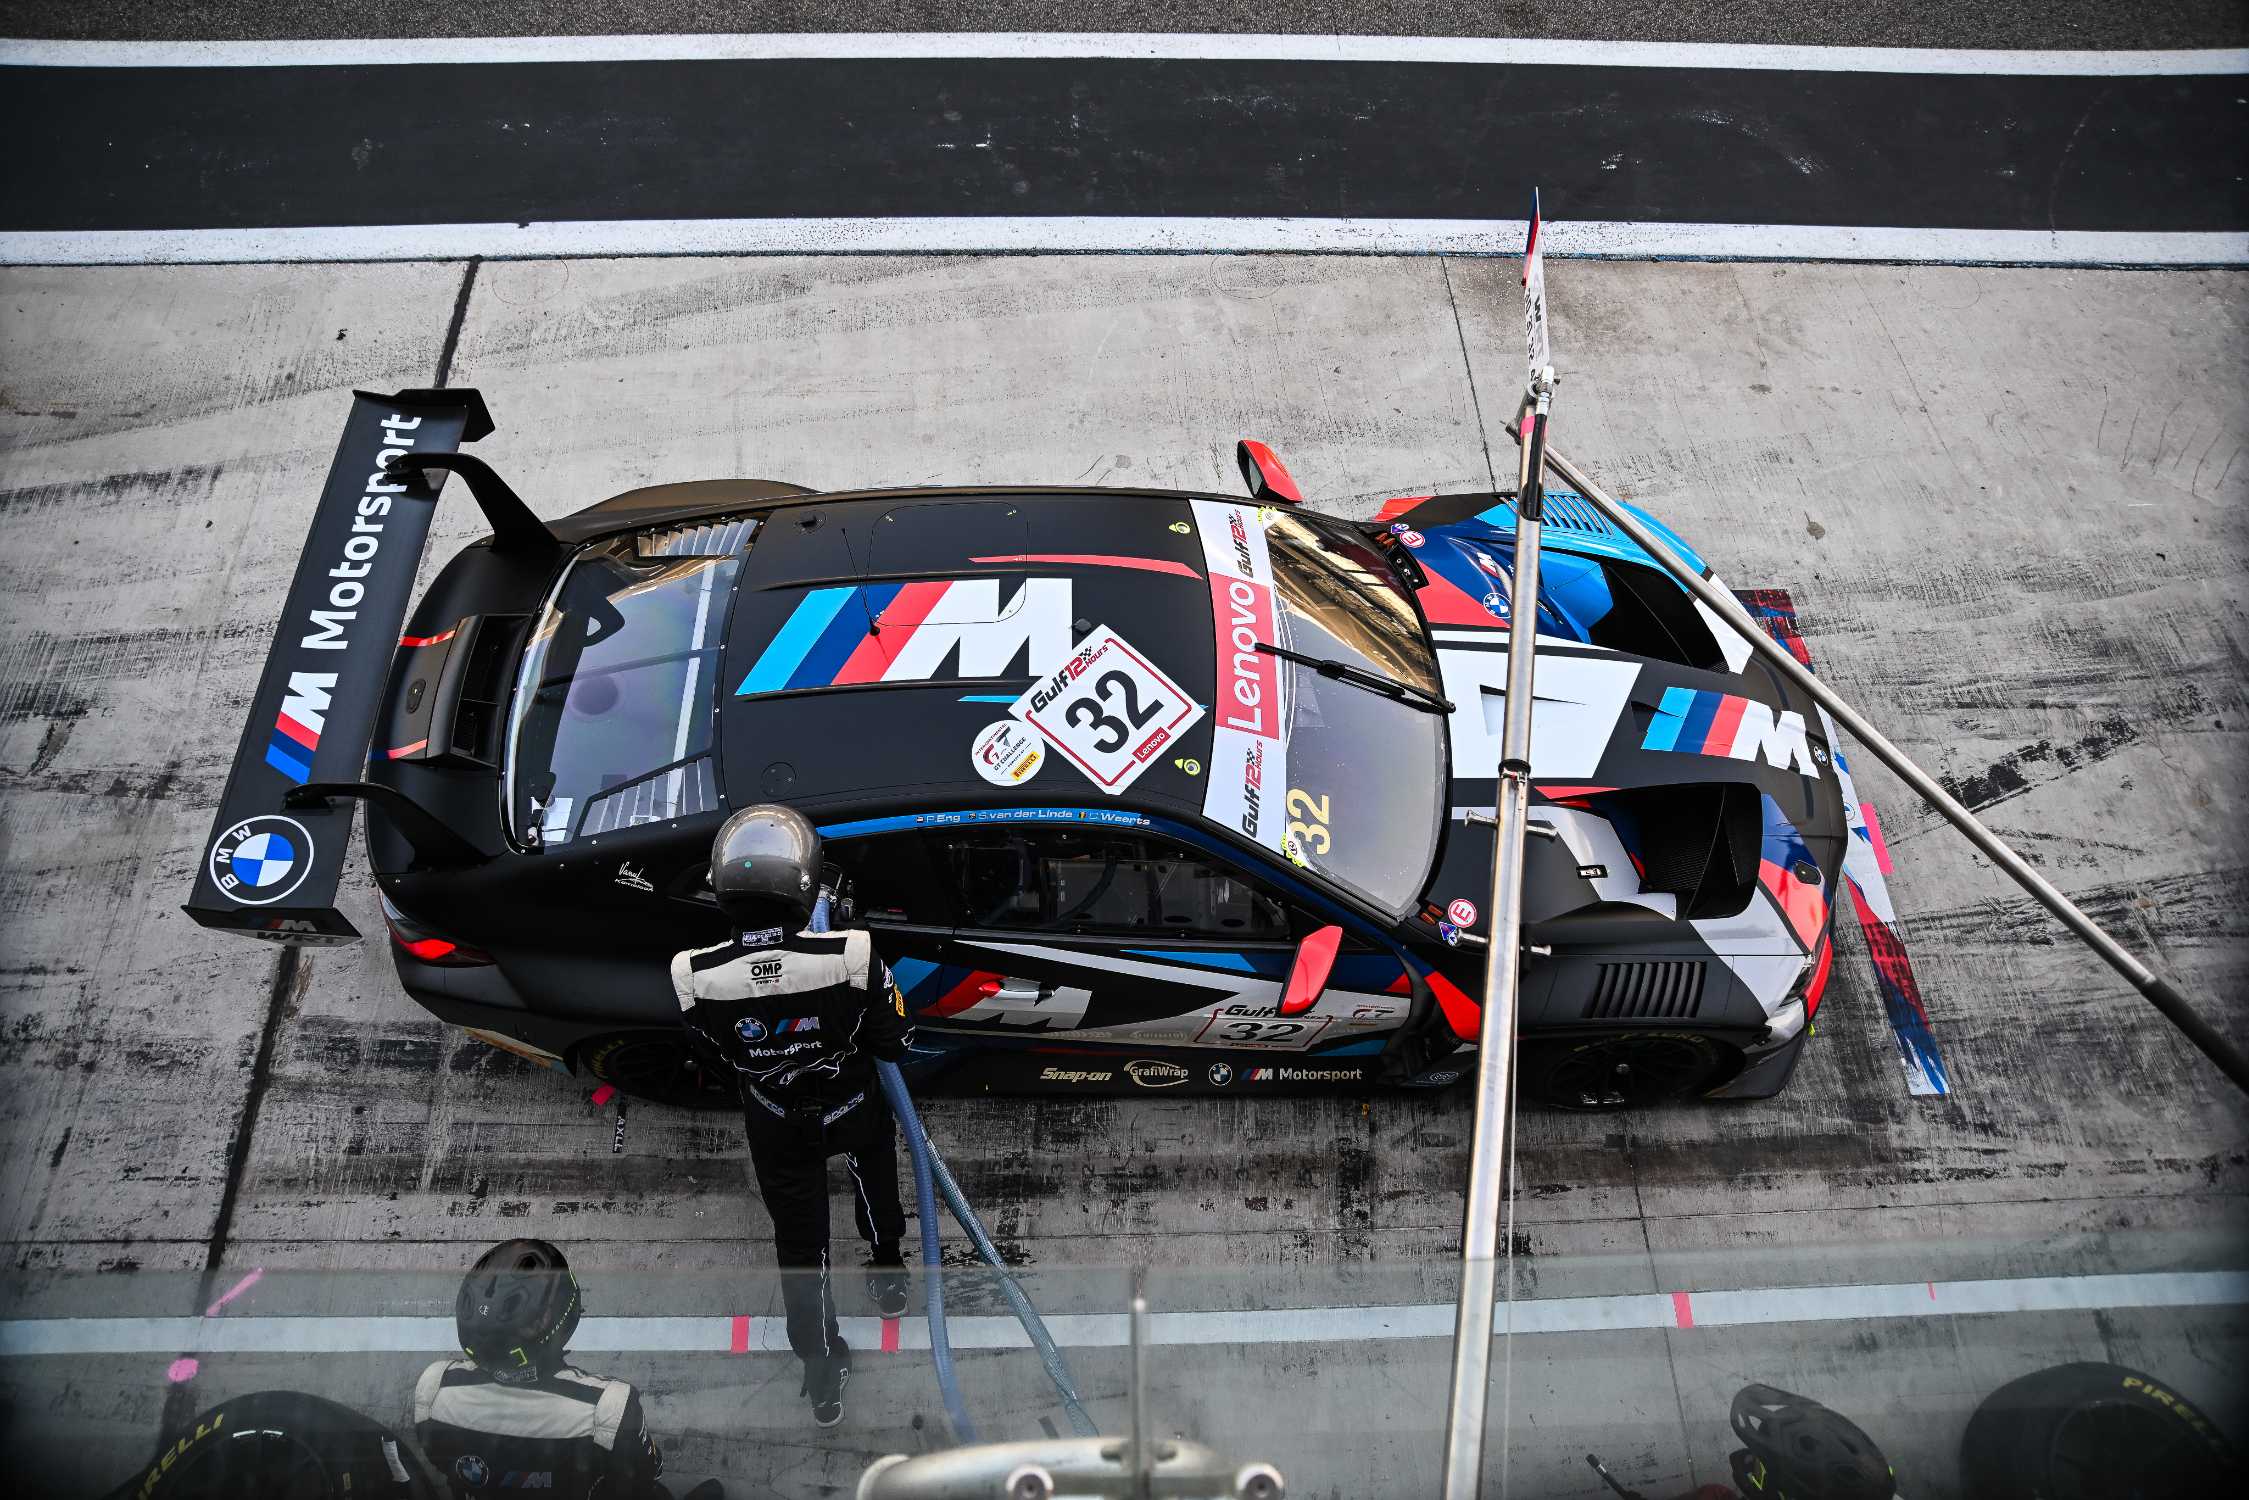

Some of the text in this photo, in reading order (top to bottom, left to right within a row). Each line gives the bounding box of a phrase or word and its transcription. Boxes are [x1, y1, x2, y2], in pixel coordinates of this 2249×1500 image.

[300, 414, 422, 650] Motorsport
[1403, 532, 1421, 545] E
[880, 577, 1073, 682] M
[1227, 581, 1262, 732] Lenovo
[1065, 669, 1165, 754] 32
[1137, 731, 1166, 759] Lenovo
[1013, 809, 1036, 818] der
[1037, 809, 1073, 818] Linde
[1286, 788, 1331, 855] 32
[1452, 903, 1471, 921] E
[751, 962, 782, 977] OMP
[1219, 1022, 1305, 1042] 32
[748, 1041, 823, 1058] Motorsport
[1040, 1067, 1113, 1083] Snap-on
[1129, 1066, 1189, 1079] GrafiWrap
[1279, 1067, 1363, 1082] Motorsport
